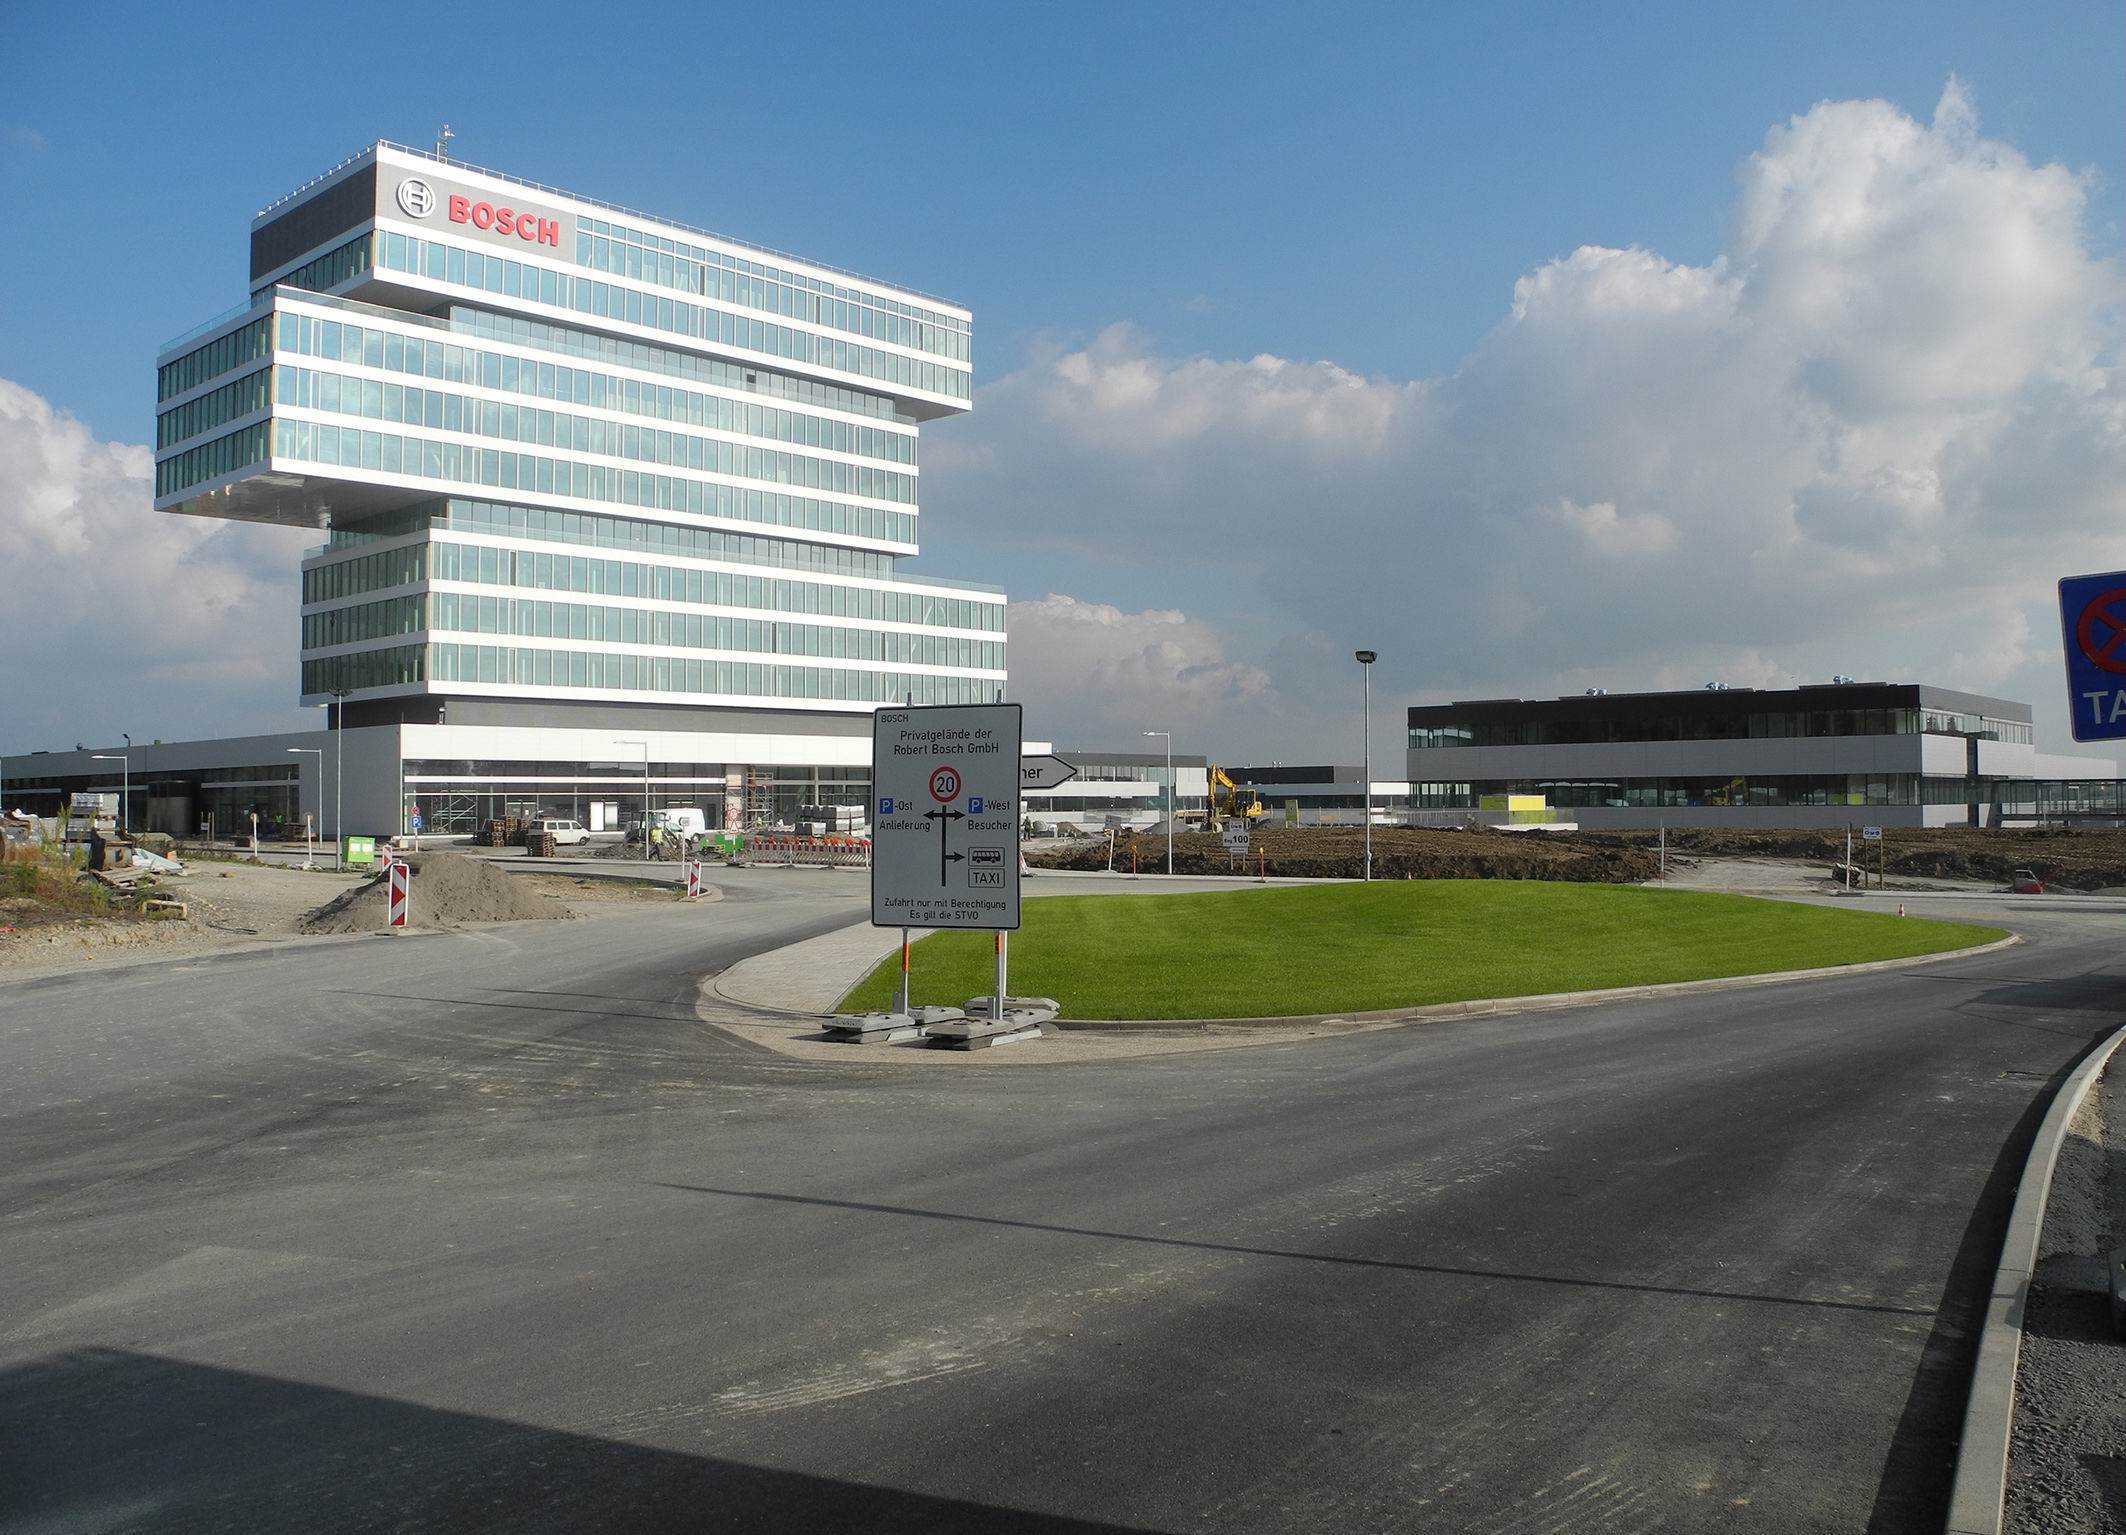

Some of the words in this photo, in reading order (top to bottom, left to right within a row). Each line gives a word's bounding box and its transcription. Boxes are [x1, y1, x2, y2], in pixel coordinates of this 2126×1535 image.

[449, 194, 560, 247] BOSCH
[881, 714, 909, 723] BOSCH
[900, 729, 970, 742] Privatgelände
[974, 728, 992, 739] der
[894, 744, 927, 755] Robert
[932, 743, 963, 755] Bosch
[968, 742, 999, 753] GmbH
[936, 776, 955, 793] 20
[879, 820, 931, 832] Anlieferung
[968, 820, 1012, 831] Besucher
[1233, 835, 1248, 843] 100
[973, 872, 1000, 884] TAXI
[884, 898, 914, 907] Zufahrt
[934, 899, 947, 907] mit
[951, 899, 1006, 911] Berechtigung
[910, 910, 920, 919] Es
[924, 911, 936, 920] gilt
[939, 910, 951, 919] die
[955, 910, 979, 920] STVO
